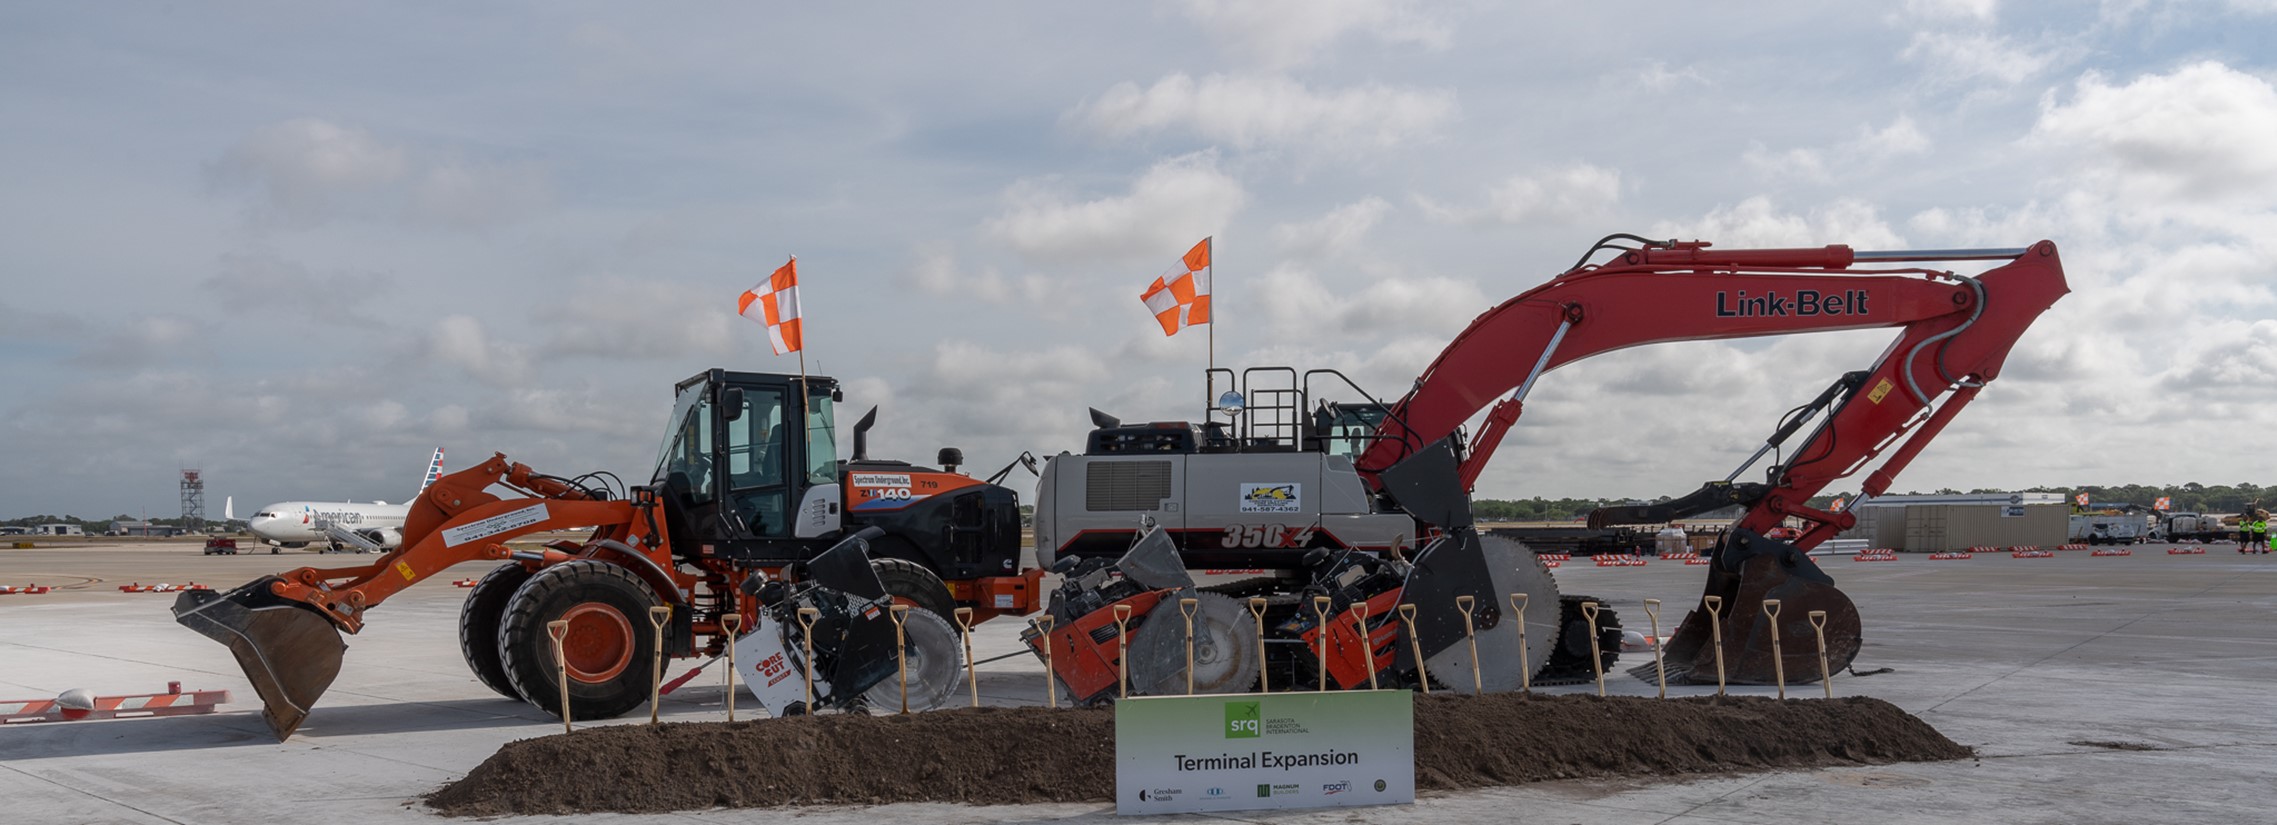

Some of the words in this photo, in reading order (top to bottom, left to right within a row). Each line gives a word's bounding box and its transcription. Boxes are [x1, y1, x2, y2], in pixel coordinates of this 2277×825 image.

[1716, 290, 1869, 317] Link-Belt
[854, 475, 874, 485] Spectrum
[921, 480, 938, 488] 719
[313, 508, 362, 524] American
[755, 651, 784, 672] CORE
[764, 660, 785, 677] CUT
[1231, 719, 1258, 735] srq
[1174, 753, 1256, 771] Terminal
[1261, 749, 1359, 770] Expansion
[1323, 783, 1347, 791] FDOT
